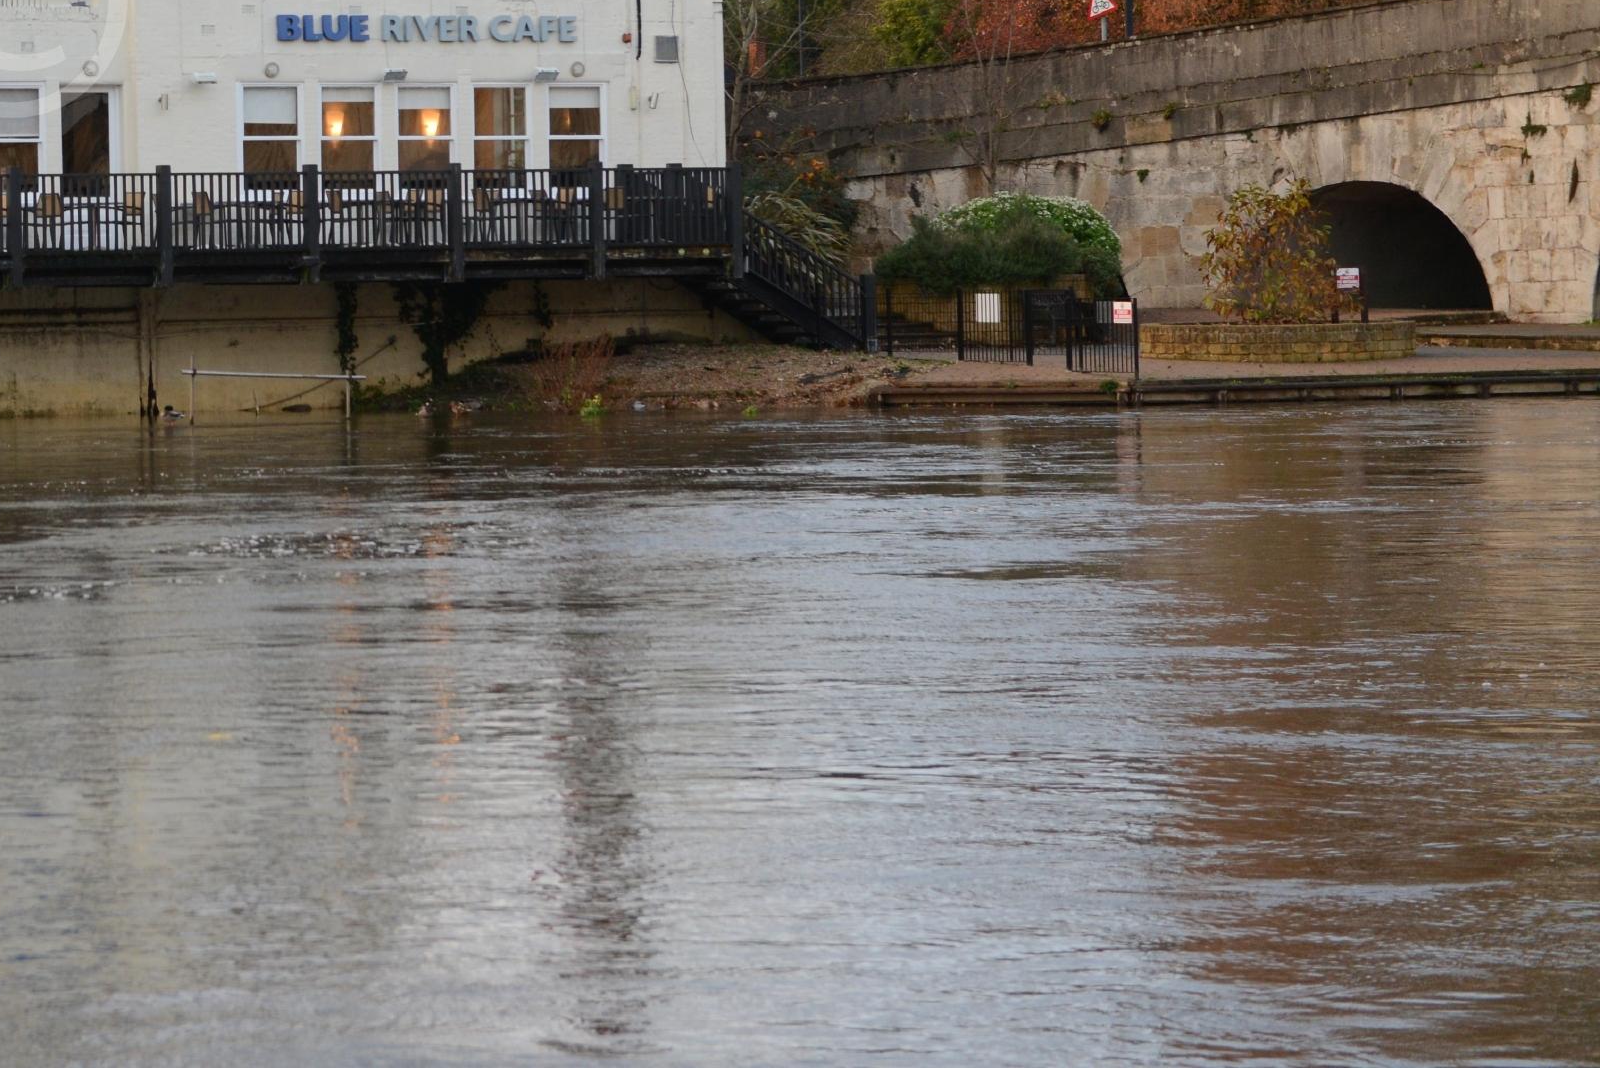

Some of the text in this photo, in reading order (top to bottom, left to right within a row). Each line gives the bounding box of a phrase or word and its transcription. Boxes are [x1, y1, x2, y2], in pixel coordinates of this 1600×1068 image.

[276, 14, 578, 42] BLUE RIVER CAFE
